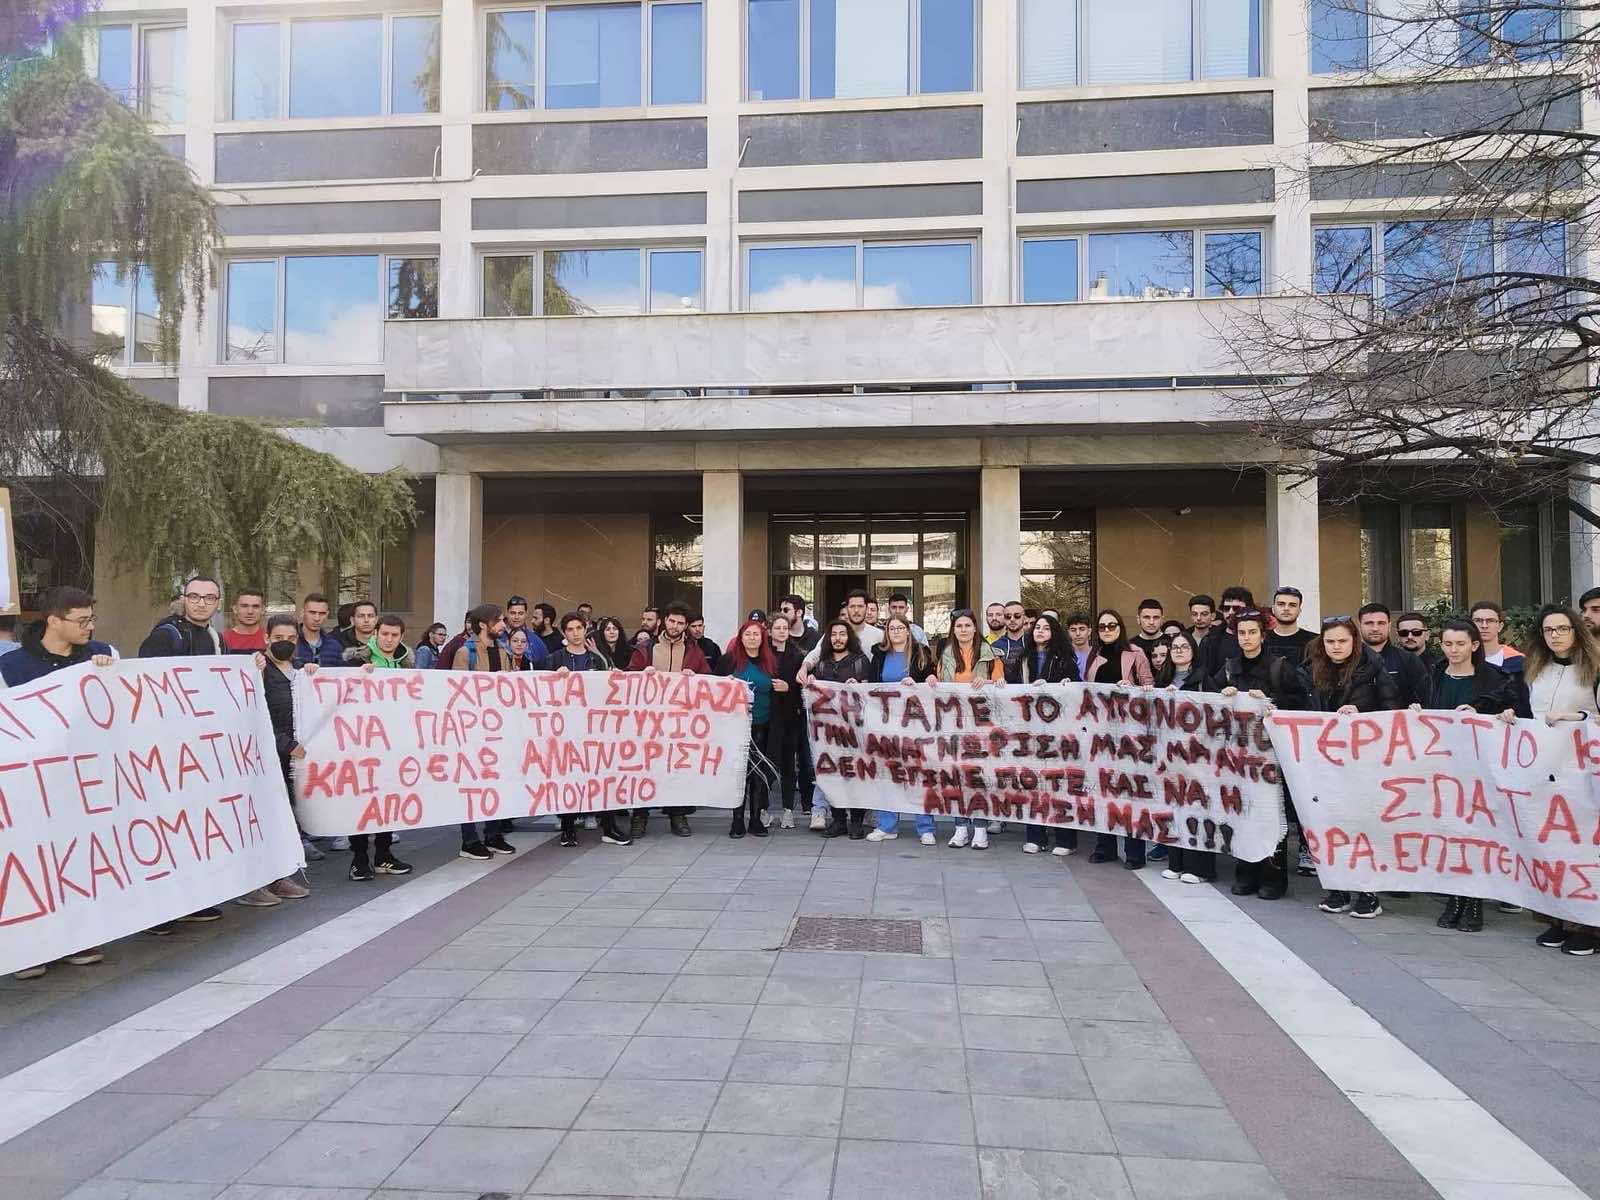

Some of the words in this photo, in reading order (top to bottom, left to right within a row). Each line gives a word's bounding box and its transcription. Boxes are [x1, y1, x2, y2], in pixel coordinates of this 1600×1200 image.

[209, 667, 257, 711] ΤΑ
[313, 674, 424, 705] ΠΕΝΤΕ
[446, 672, 588, 709] ΧΡΟΝΙΑ
[1011, 694, 1060, 724] ΤΟ
[333, 715, 391, 751] ΝΑ
[415, 708, 503, 750] ΠΑΡΩ
[528, 711, 565, 736] ΤΟ
[587, 708, 711, 739] ΠΤΥΧΙΟ
[1272, 709, 1537, 768] ΤΕΡΑΣΤΙΟ
[303, 757, 382, 799] ΚΑΙ
[399, 746, 500, 787] ΘΕΛΩ
[815, 752, 877, 781] ΔΕΝ
[885, 760, 988, 793] ΕΓΙΝΕ
[994, 766, 1087, 797] ΠΟΤΕ
[1099, 767, 1153, 798] ΚΑΙ
[1164, 773, 1210, 809] ΝΑ
[1220, 785, 1242, 815] Η
[357, 793, 423, 832] ΑΠΟ
[459, 787, 500, 822] ΤΟ
[525, 775, 657, 816] ΥΠΟΥΡΓΕΙΟ
[1380, 774, 1600, 845] ΣΠΑΤΑ
[0, 794, 264, 926] ΔΙΚΑΙΩΜΑΤΑ
